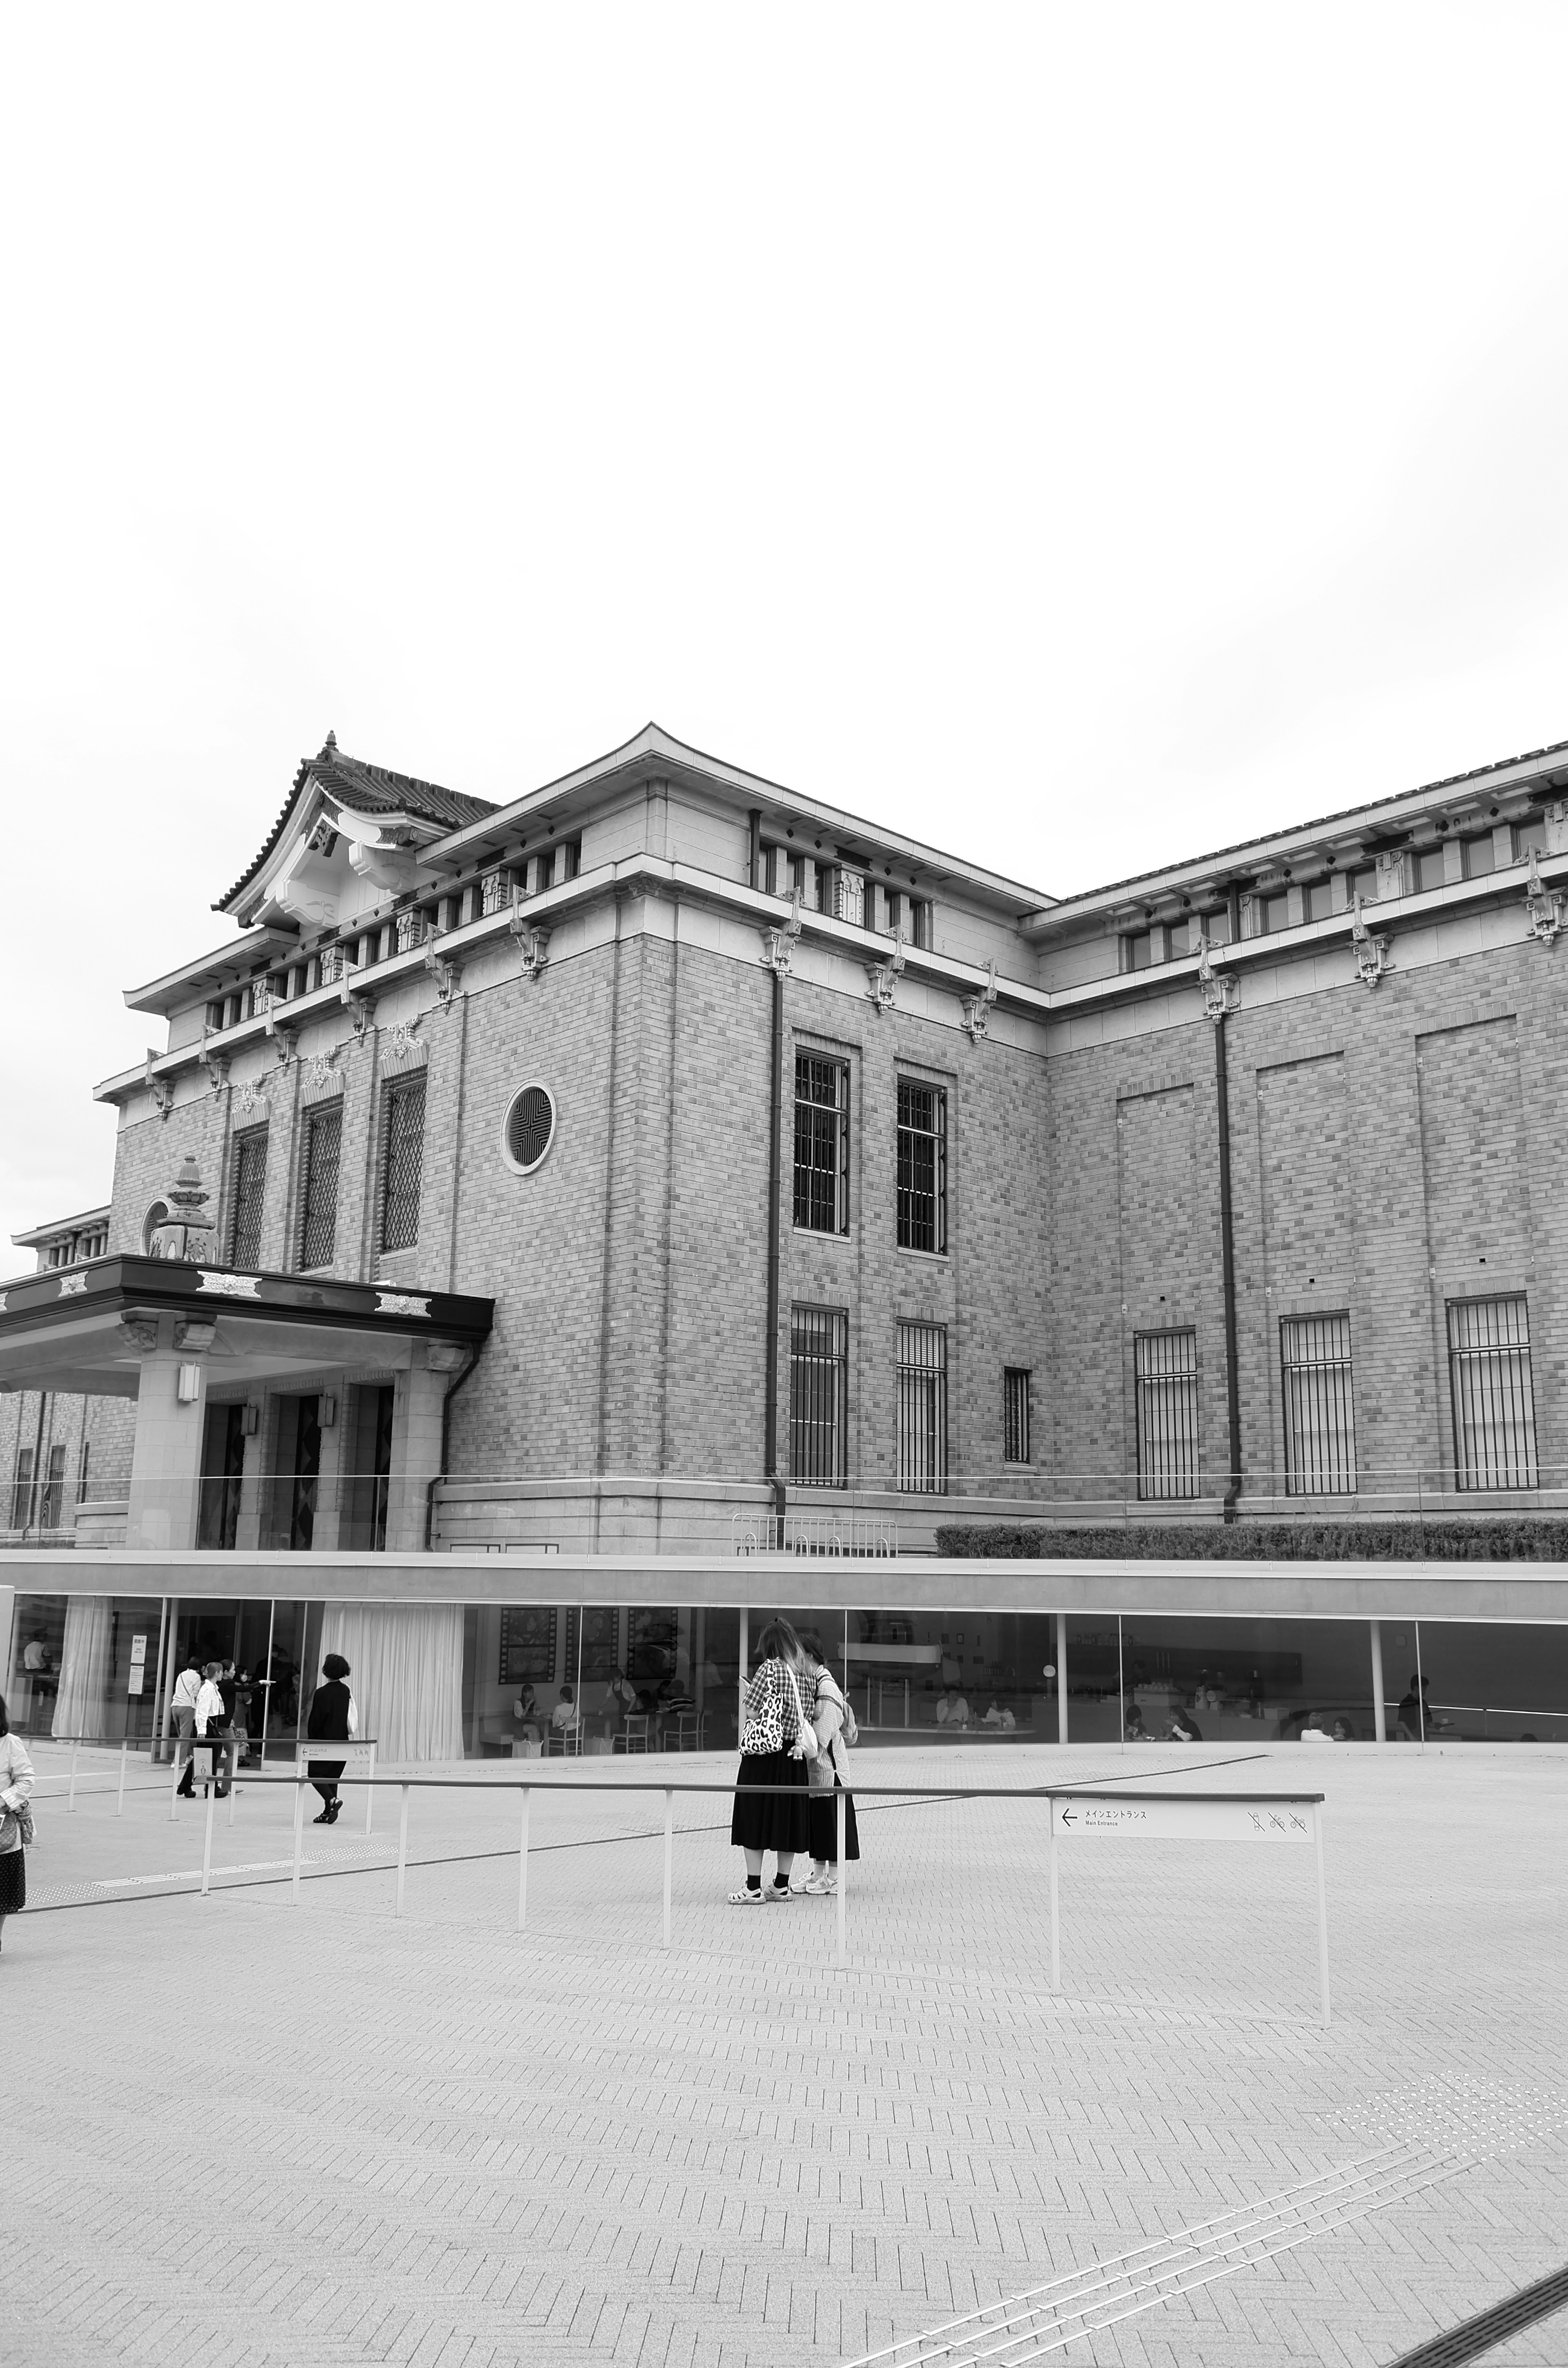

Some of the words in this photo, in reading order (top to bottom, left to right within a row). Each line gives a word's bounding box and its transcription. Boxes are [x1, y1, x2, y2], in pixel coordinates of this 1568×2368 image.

[1086, 1810, 1146, 1818] メインエントランス
